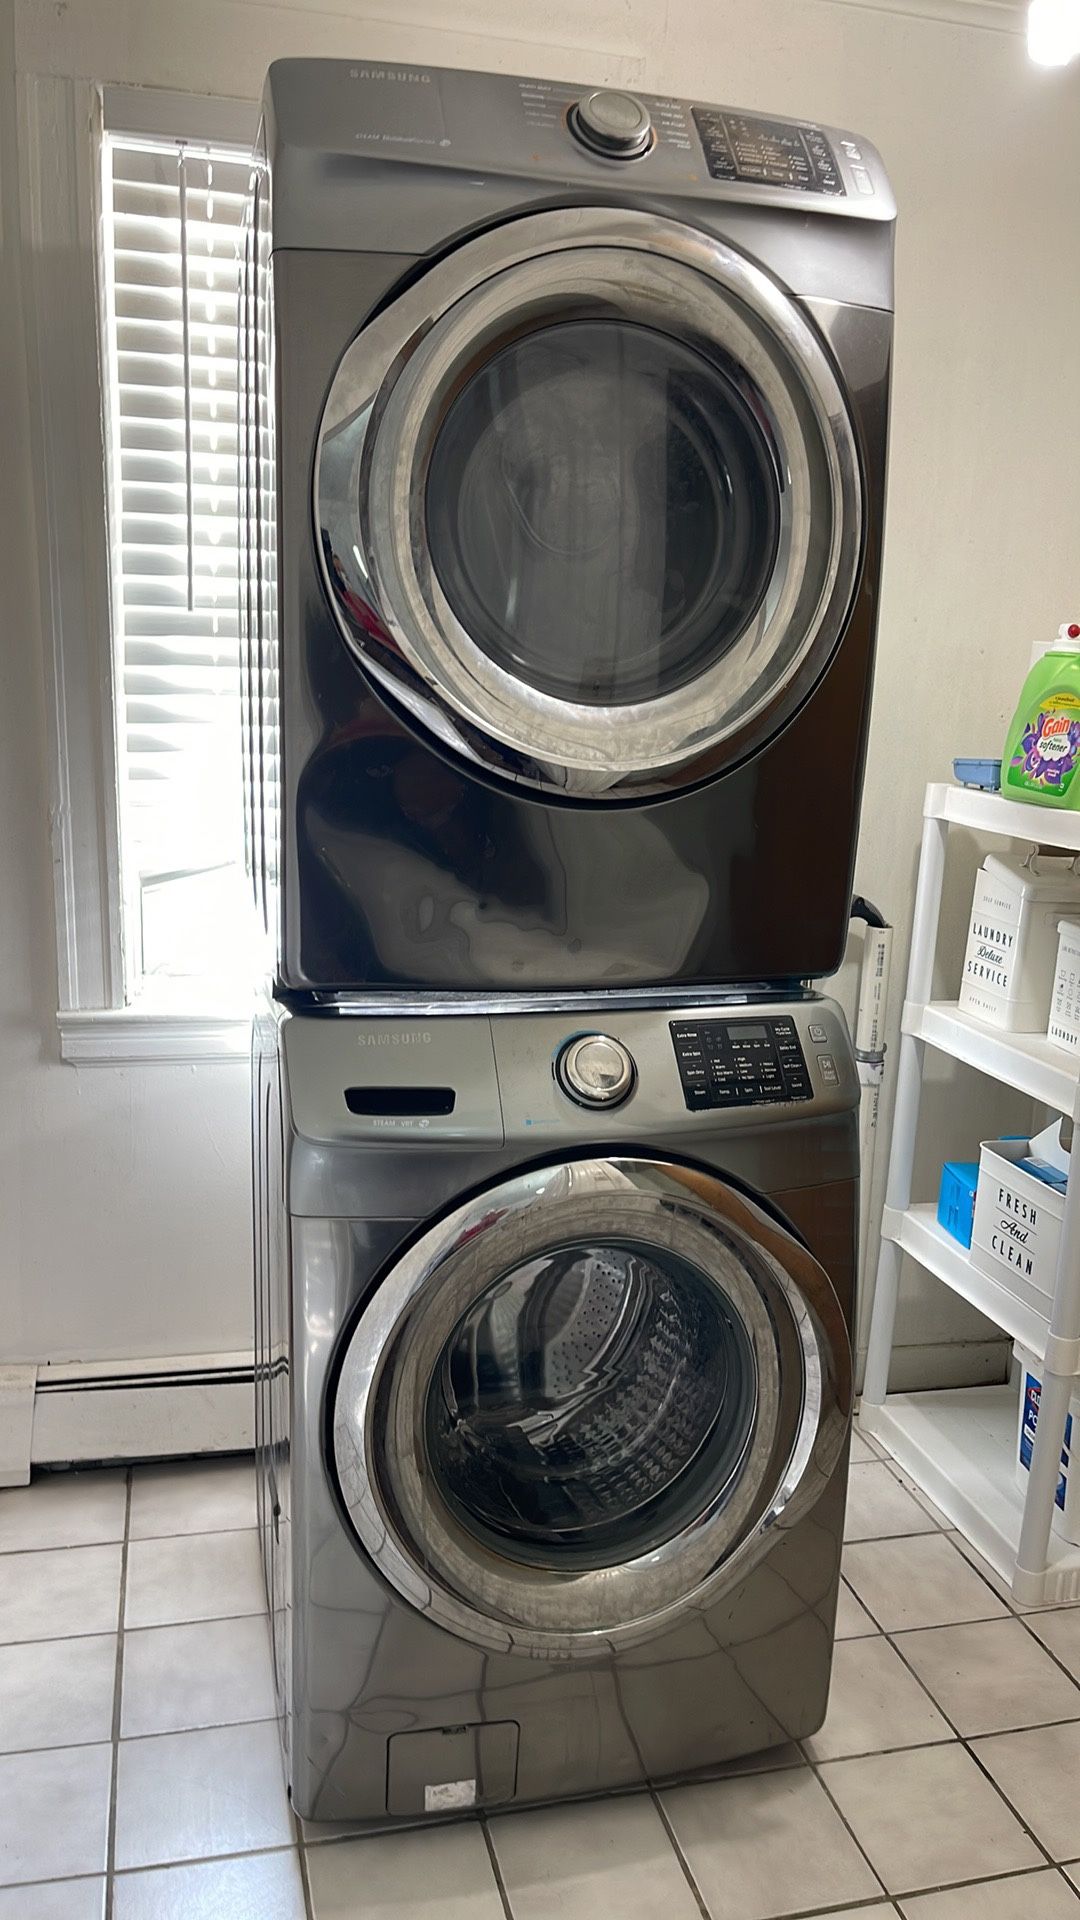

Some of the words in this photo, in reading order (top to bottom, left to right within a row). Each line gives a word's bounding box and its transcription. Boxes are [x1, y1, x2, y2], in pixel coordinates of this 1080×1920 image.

[350, 68, 431, 83] SAMSUNG
[1043, 717, 1070, 738] Gain
[1039, 740, 1067, 752] softener
[972, 922, 1013, 948] LAUNDRY
[977, 945, 1003, 965] Deluxe
[967, 960, 1008, 988] SERVICE
[358, 1032, 432, 1046] SAMSUNG
[1051, 1026, 1078, 1046] LAUNDRY
[998, 1187, 1037, 1226] FRESH
[1000, 1219, 1029, 1244] And
[991, 1235, 1033, 1276] CLEAN
